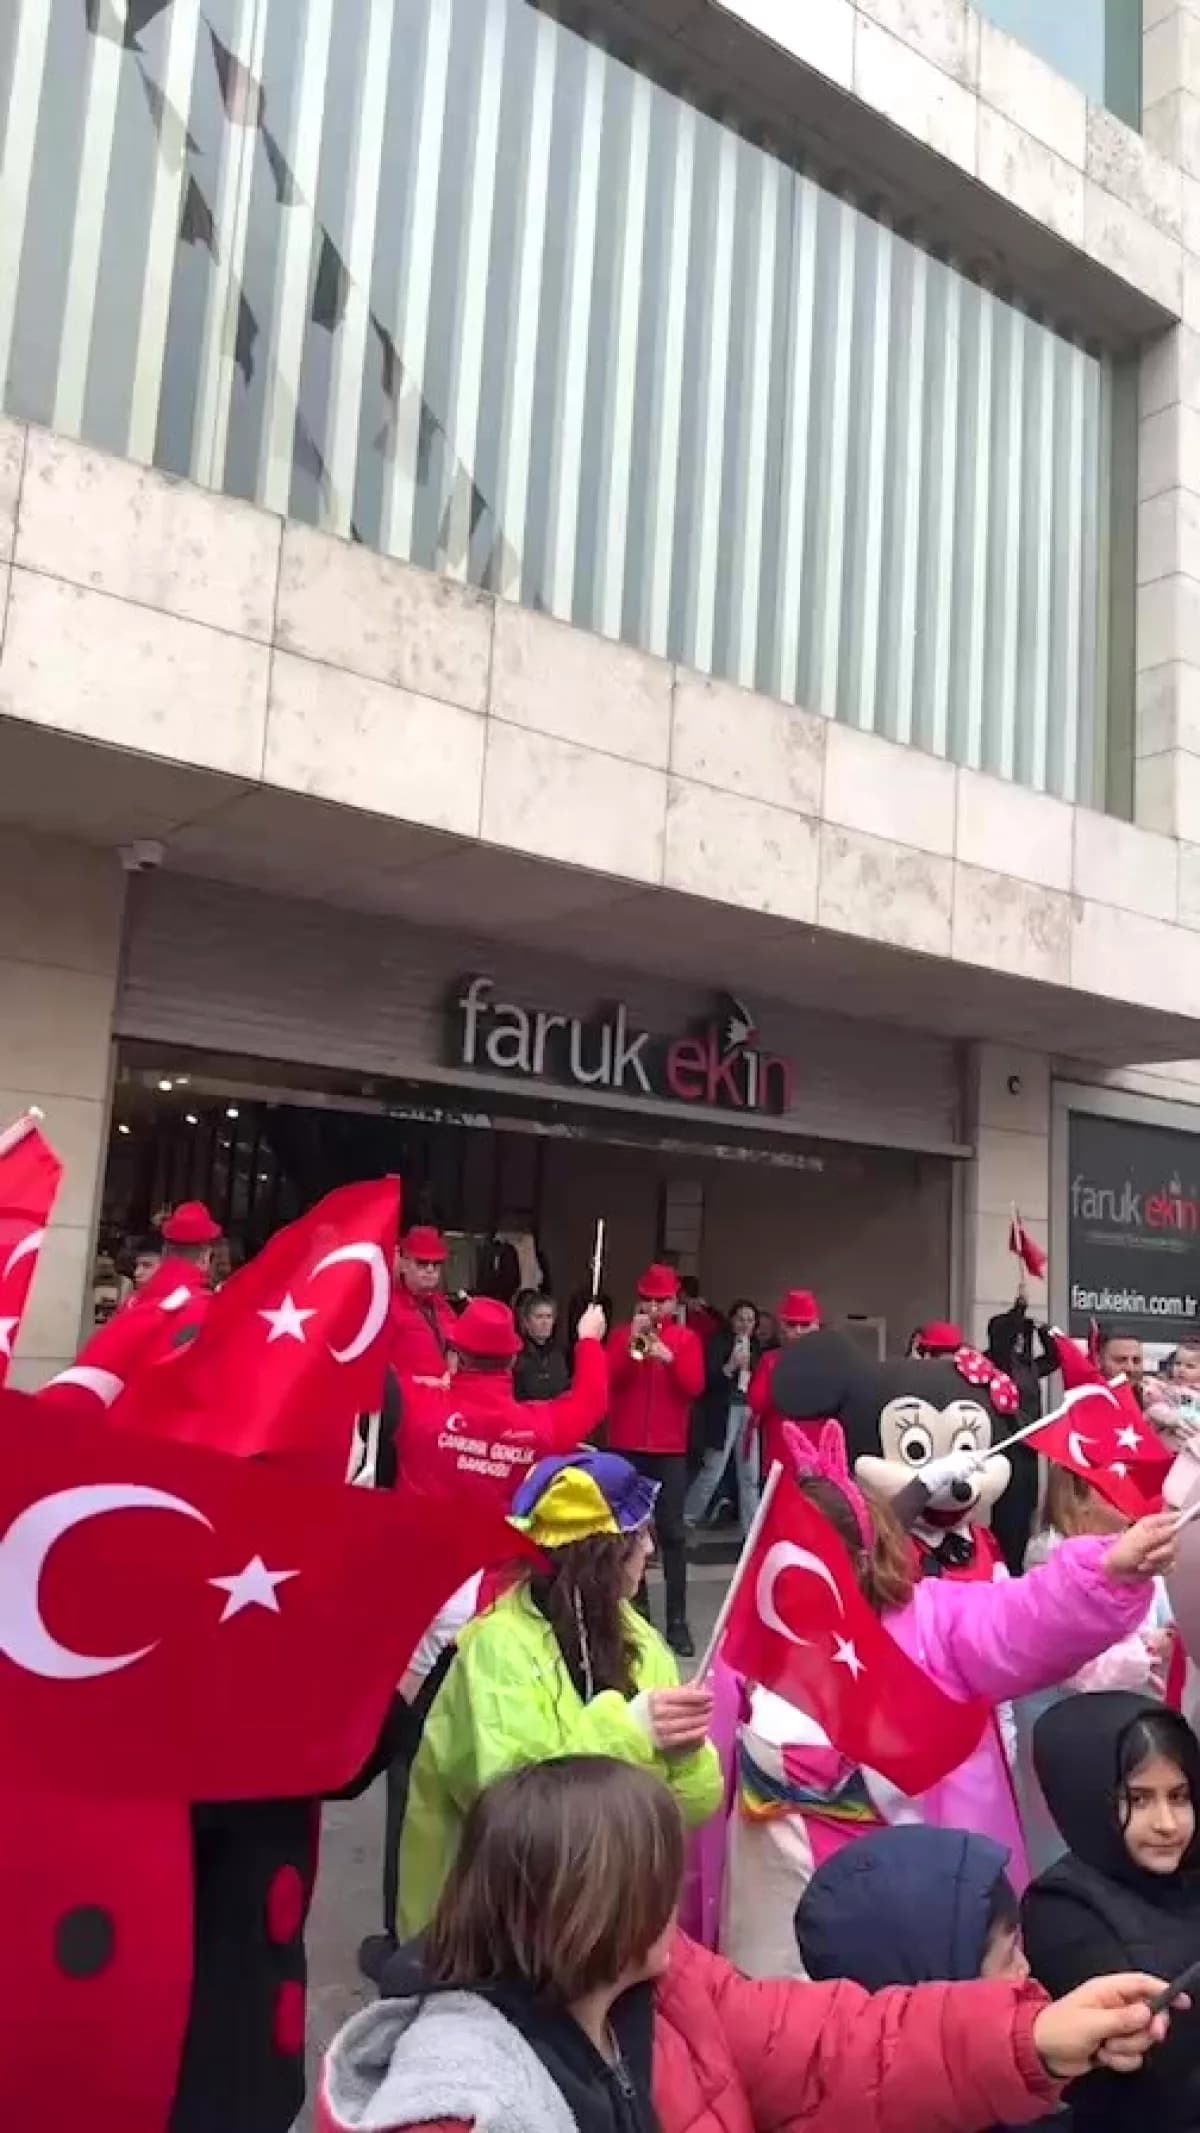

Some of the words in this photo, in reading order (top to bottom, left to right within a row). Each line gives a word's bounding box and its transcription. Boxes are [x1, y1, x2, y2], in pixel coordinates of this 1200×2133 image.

[459, 977, 651, 1091] faruk
[666, 1022, 797, 1116] ekin
[1071, 1175, 1142, 1227] faruk
[1144, 1184, 1200, 1235] ekin
[1072, 1285, 1197, 1316] farukekin.com.tr
